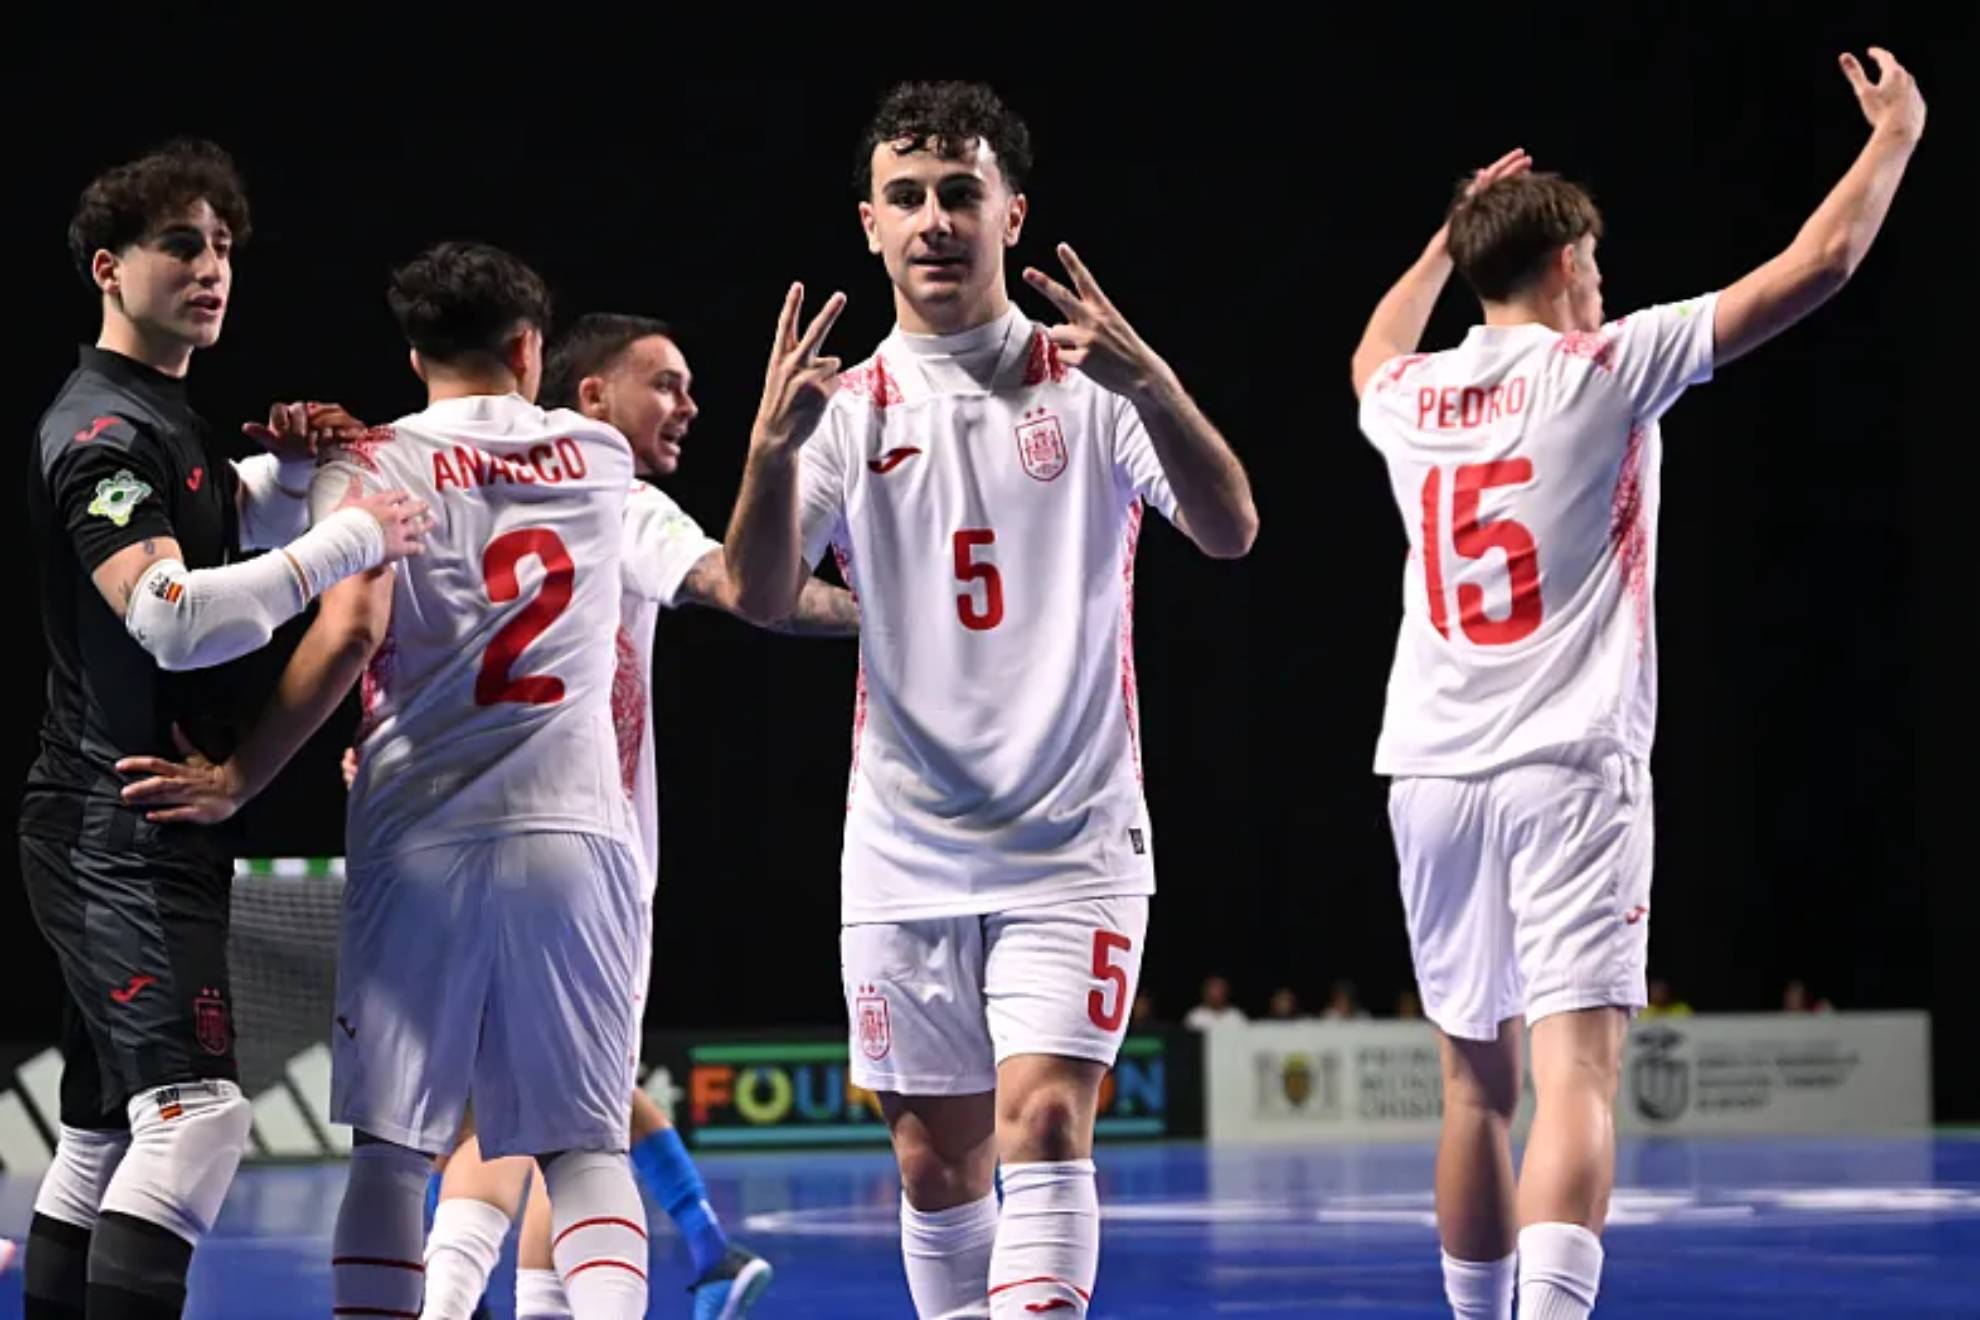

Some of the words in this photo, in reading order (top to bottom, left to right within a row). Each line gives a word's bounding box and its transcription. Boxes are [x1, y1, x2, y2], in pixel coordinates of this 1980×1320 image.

[1418, 378, 1526, 430] PEDRO
[952, 529, 1005, 630] 5
[1420, 456, 1543, 646] 15
[474, 527, 576, 706] 2
[1087, 928, 1132, 1032] 5
